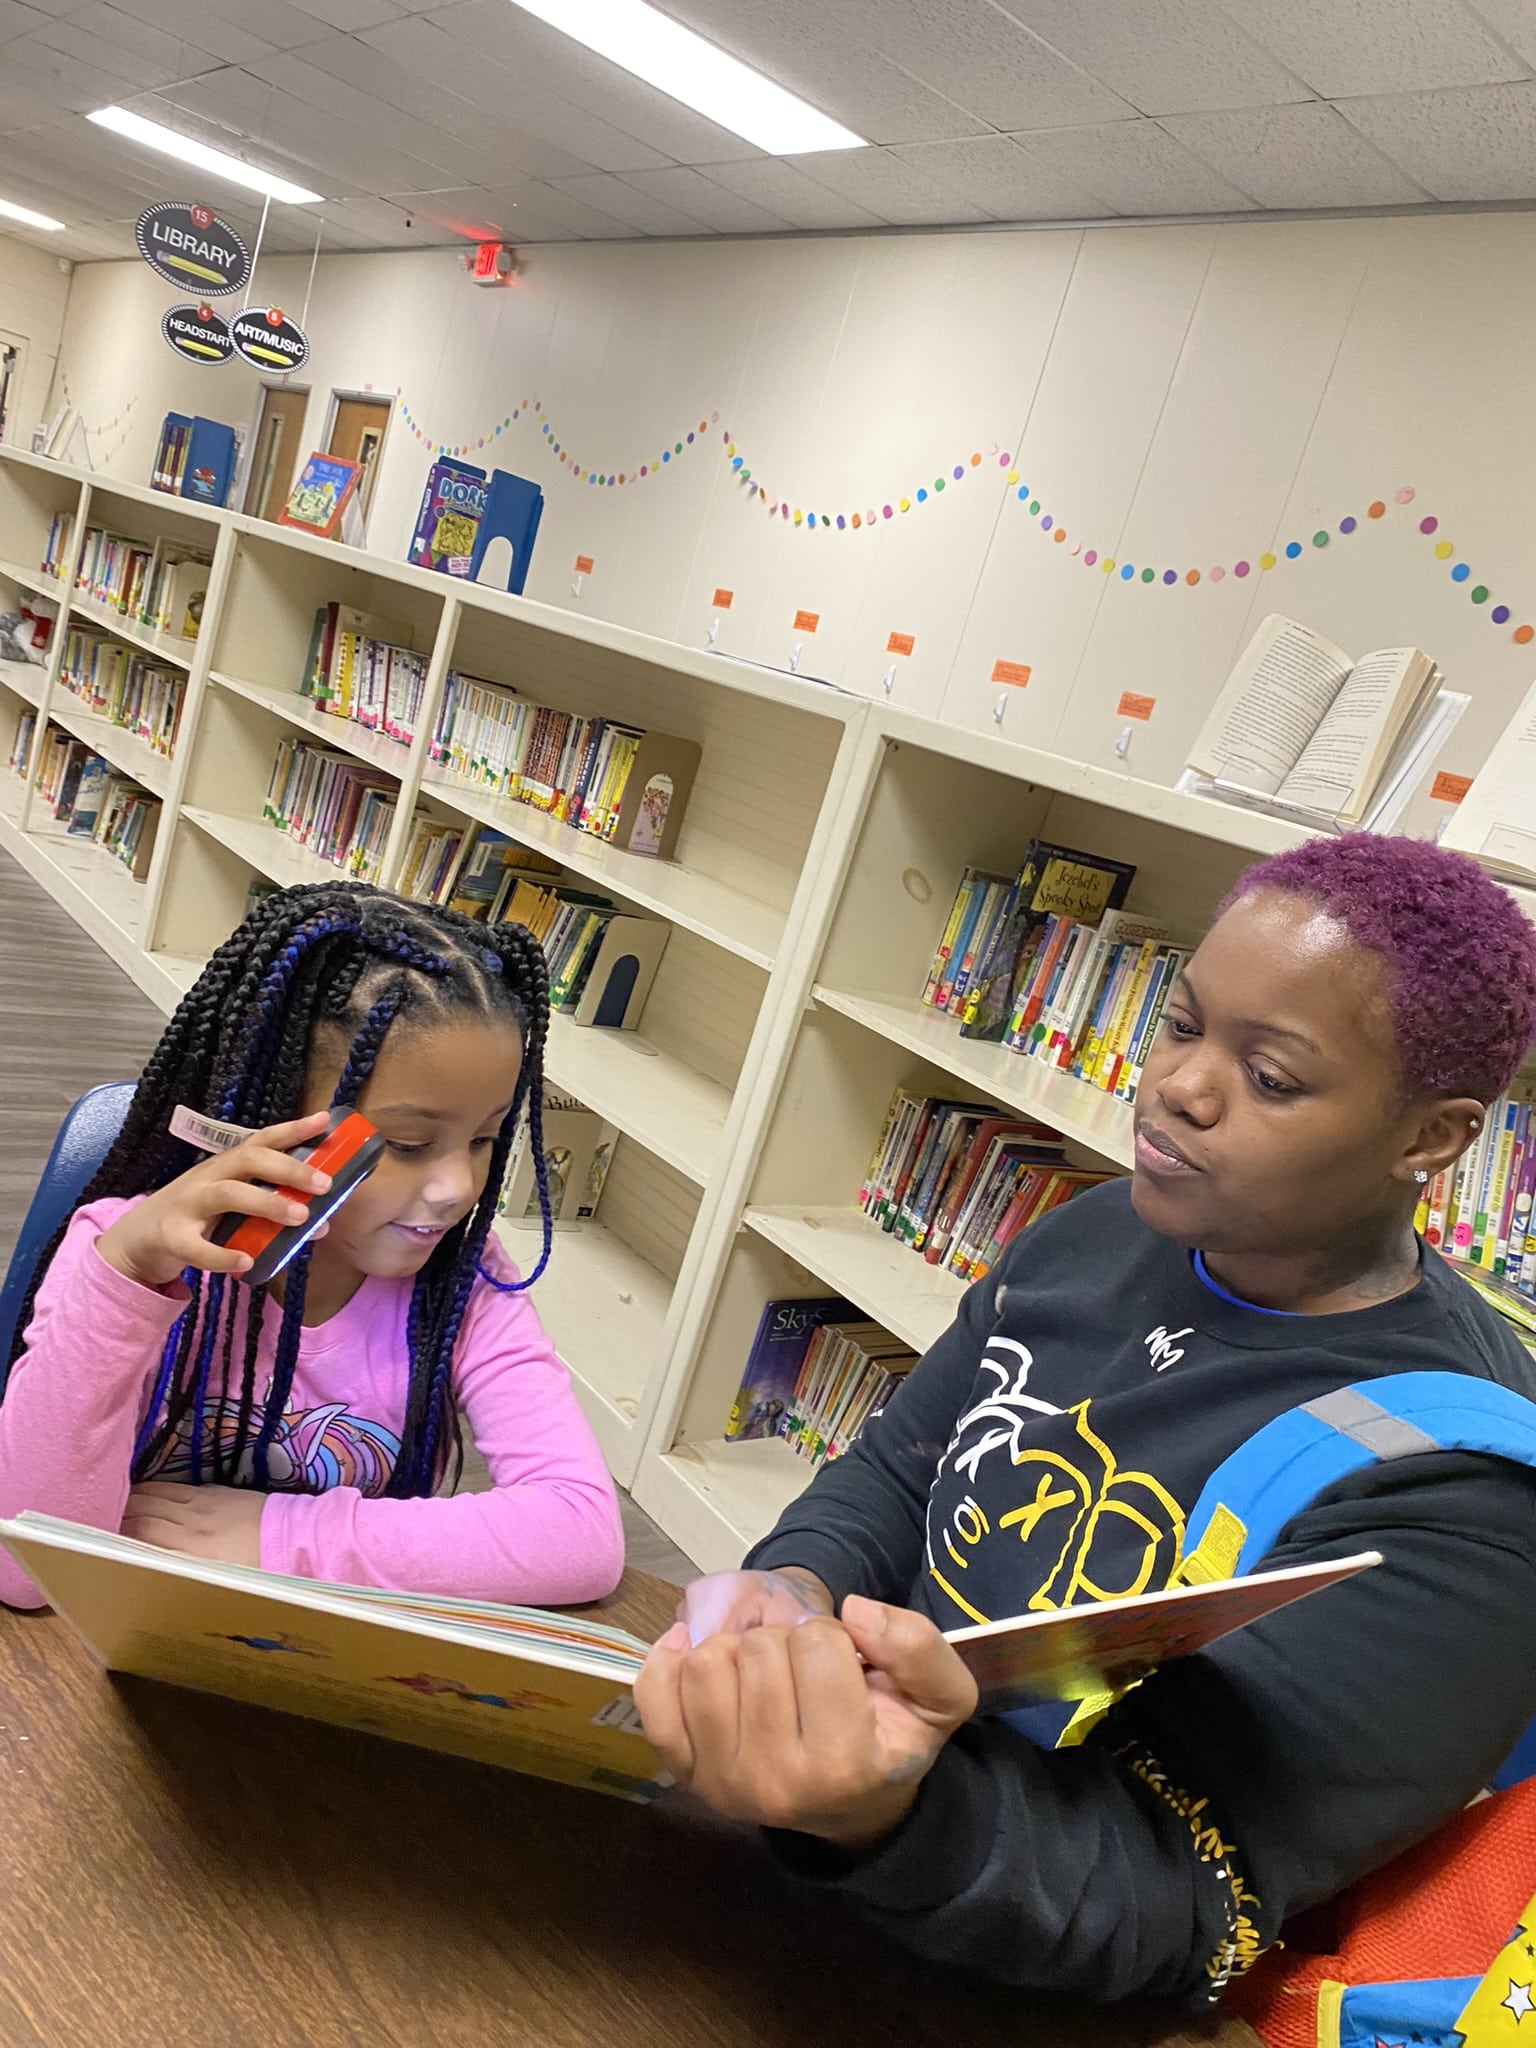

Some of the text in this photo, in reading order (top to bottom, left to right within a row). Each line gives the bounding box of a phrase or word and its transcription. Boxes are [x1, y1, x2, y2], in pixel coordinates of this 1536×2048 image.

[195, 210, 208, 222] 15
[152, 221, 237, 268] LIBRARY
[169, 318, 231, 347] HEADSTART
[234, 322, 305, 356] ART/MUSIC
[438, 477, 488, 512] DORK
